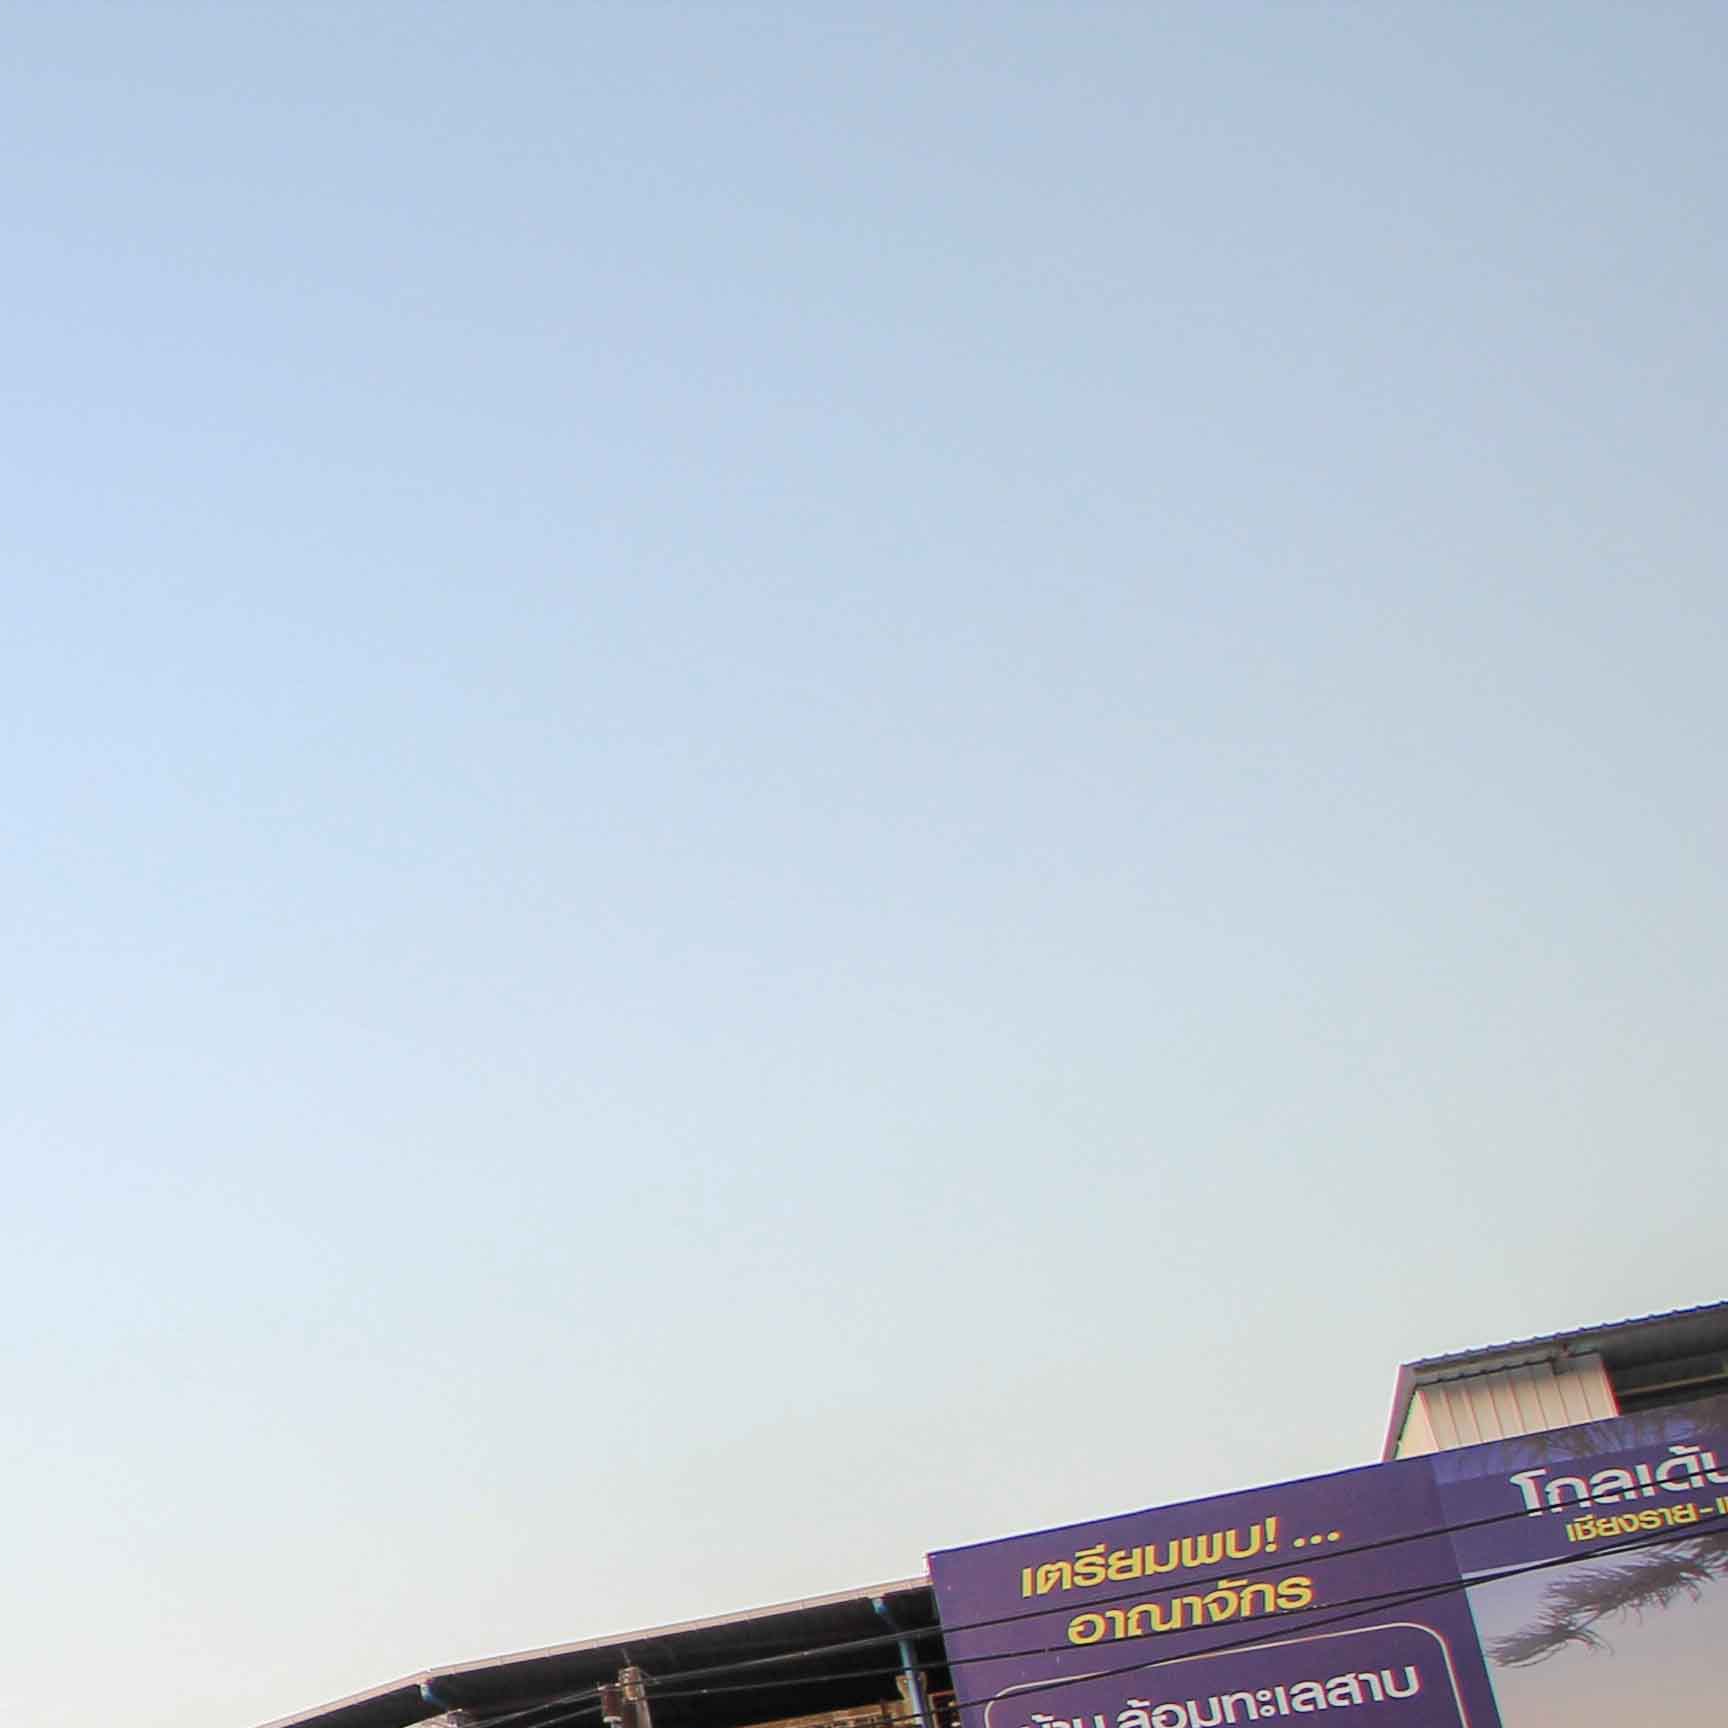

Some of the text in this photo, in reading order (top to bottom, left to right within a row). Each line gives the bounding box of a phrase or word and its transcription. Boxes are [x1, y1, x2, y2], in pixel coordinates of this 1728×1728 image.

[1021, 1517, 1279, 1597] เตรียมพบ!
[1565, 1503, 1699, 1543] เชียงราย
[1067, 1576, 1313, 1646] อาณาจักร
